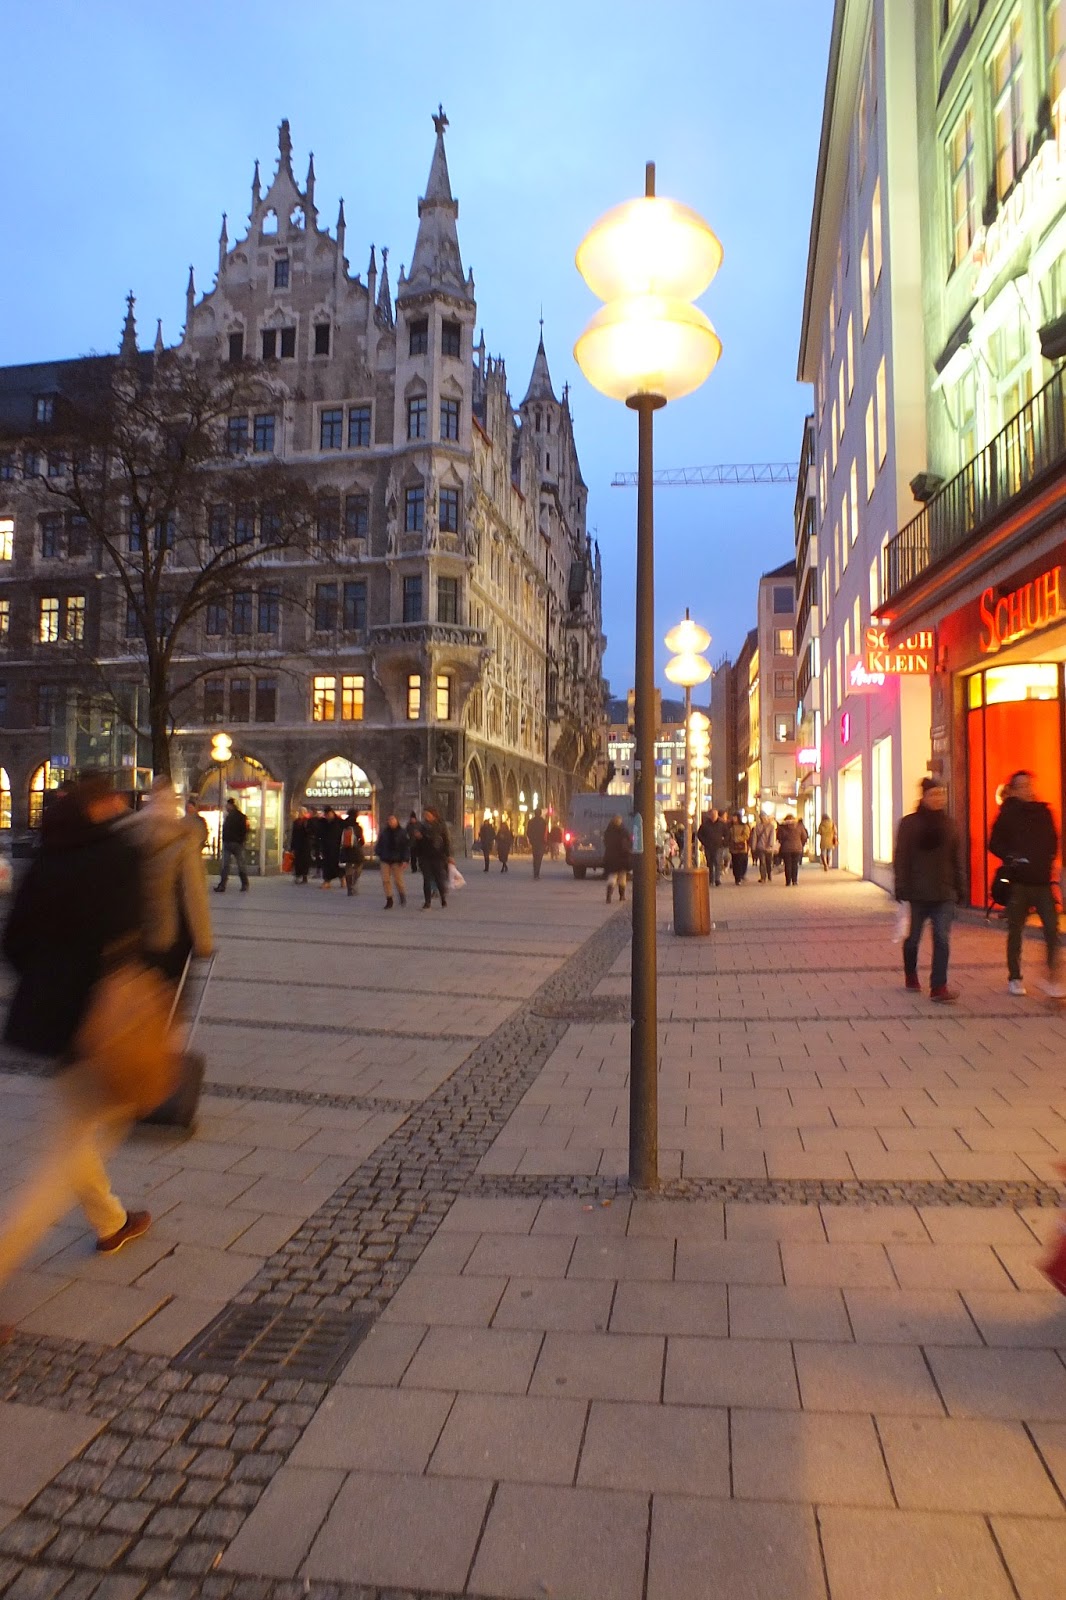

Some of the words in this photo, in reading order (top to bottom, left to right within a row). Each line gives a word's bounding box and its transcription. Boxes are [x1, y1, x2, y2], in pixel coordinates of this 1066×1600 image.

[980, 566, 1062, 653] SCHUH
[866, 628, 933, 650] SCUH
[868, 651, 928, 672] KLEIN
